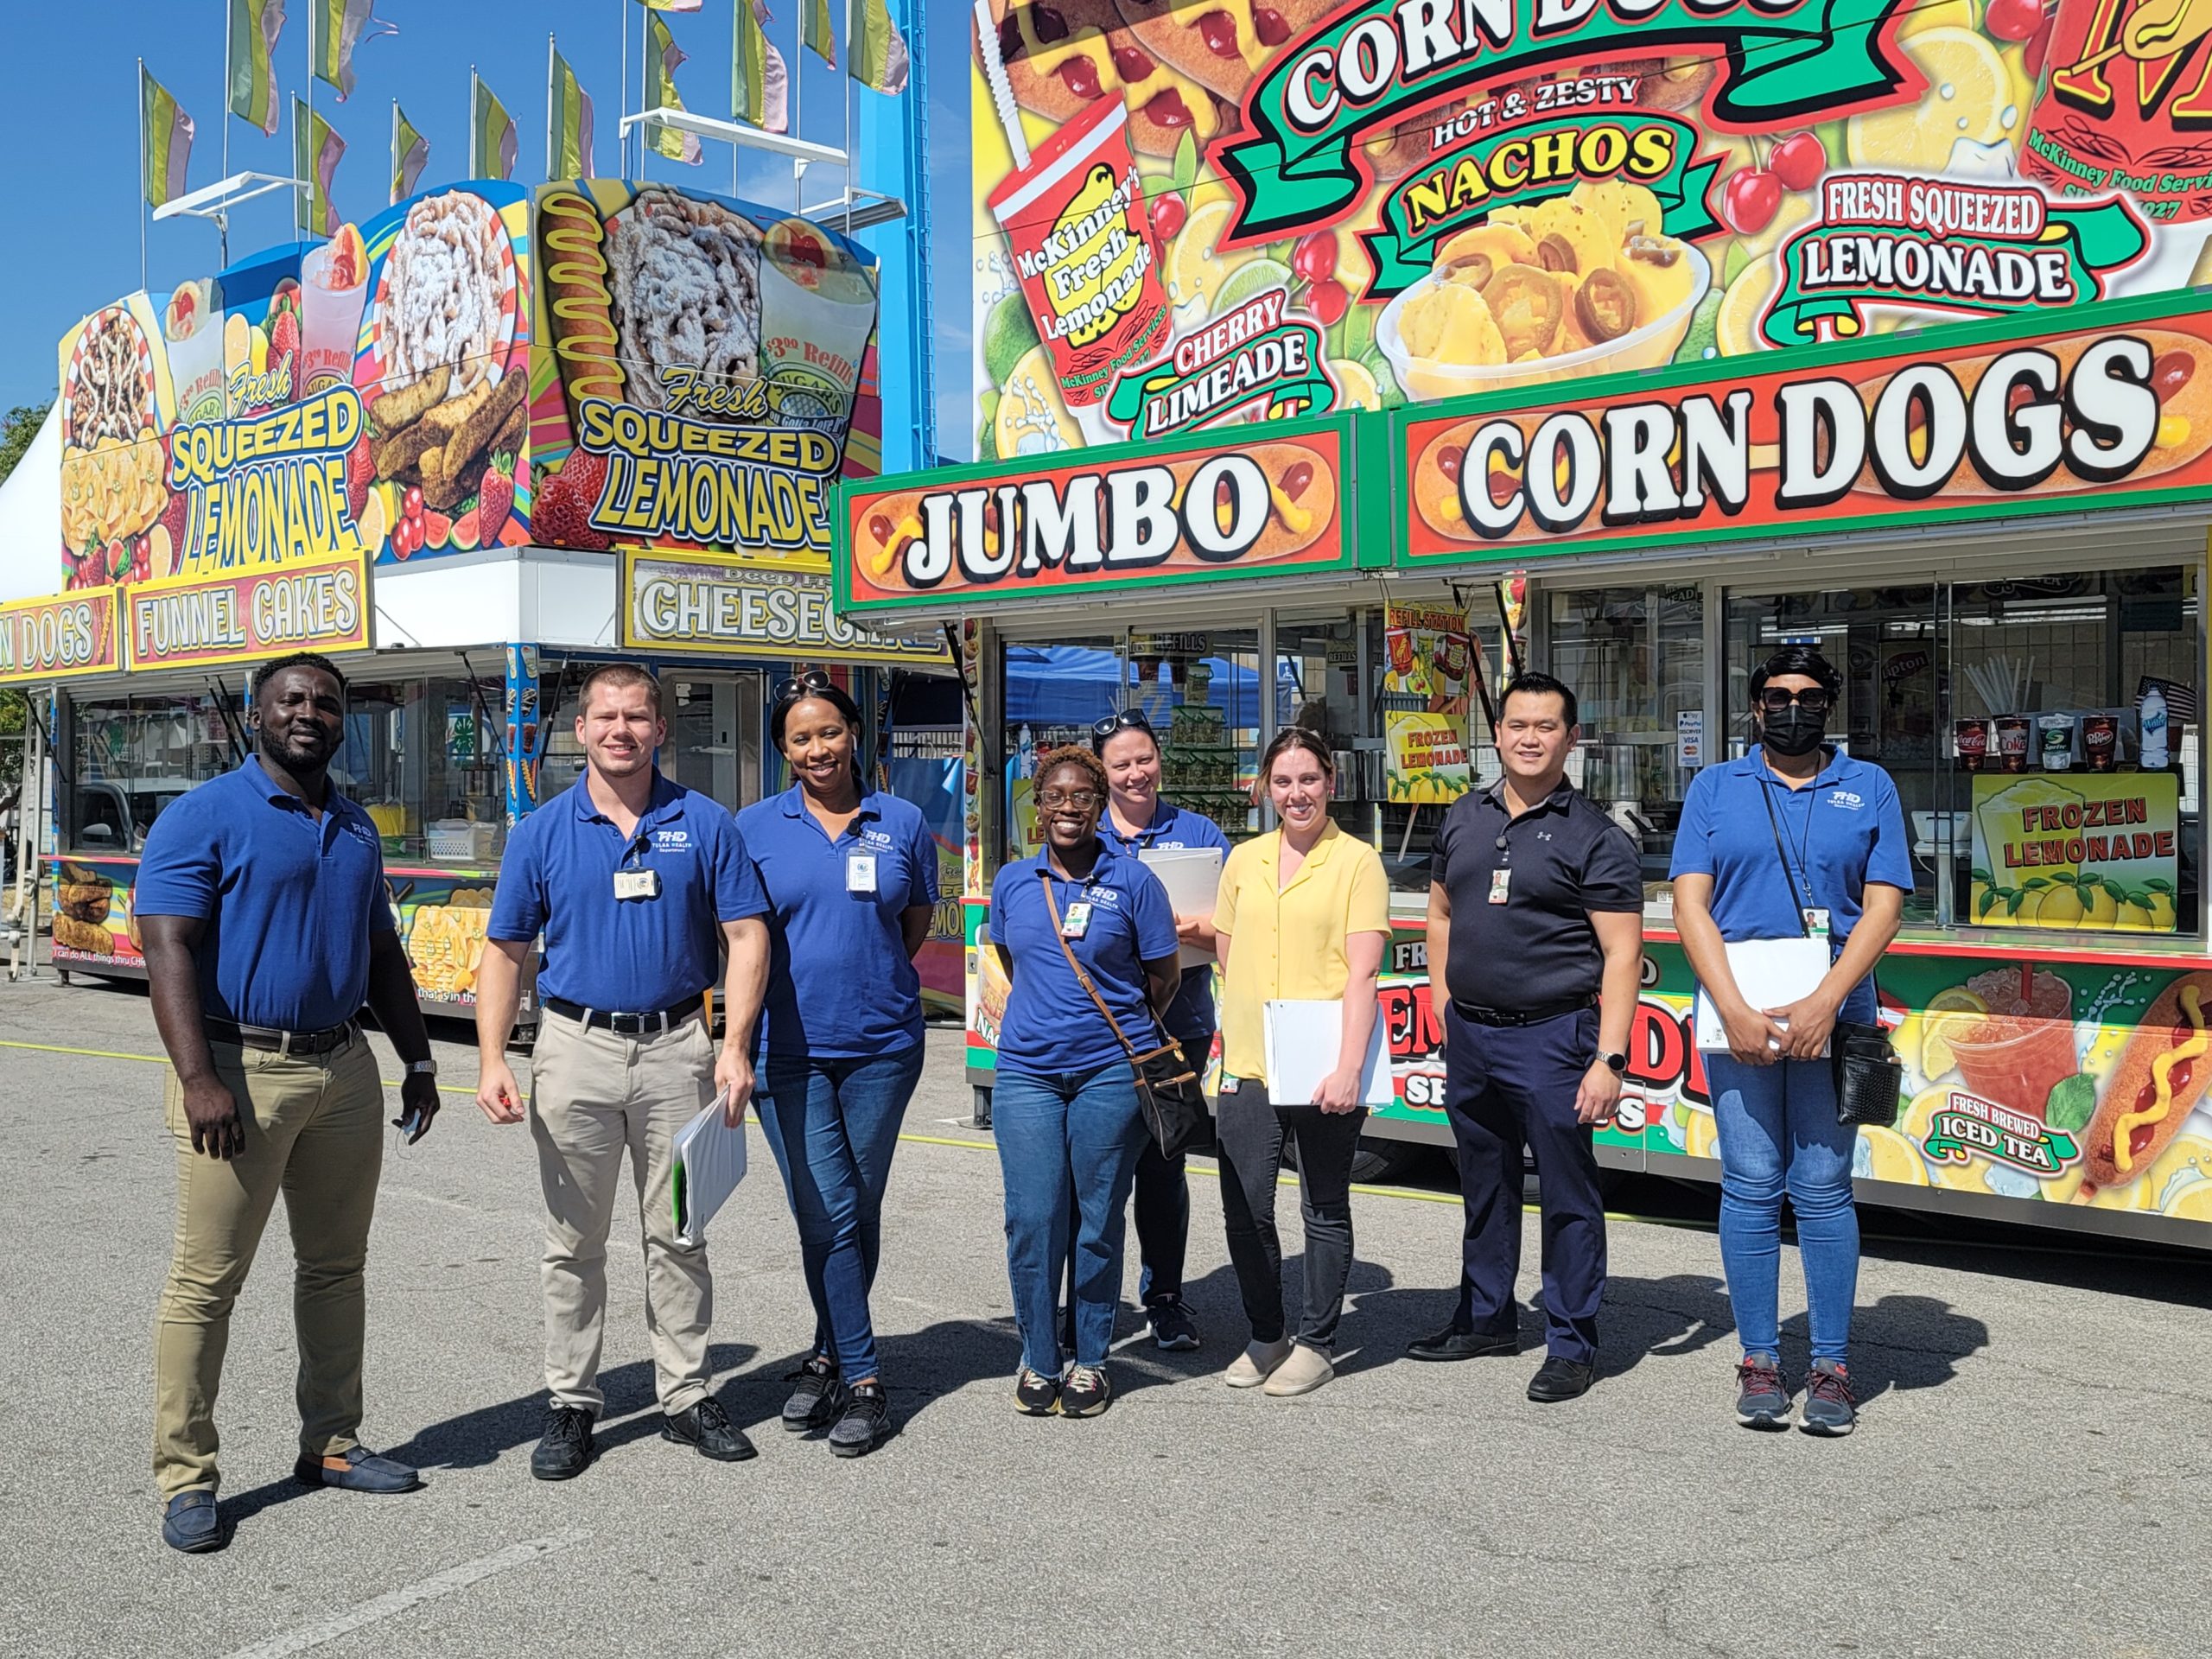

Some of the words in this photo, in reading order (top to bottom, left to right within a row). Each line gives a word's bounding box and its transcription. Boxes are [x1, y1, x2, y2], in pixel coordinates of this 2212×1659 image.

[1286, 0, 1512, 124] CORN
[1433, 101, 1496, 148] HOT
[1503, 92, 1528, 119] &
[1537, 78, 1638, 112] ZESTY
[1406, 129, 1673, 227] NACHOS
[2027, 128, 2107, 188] McKinney
[2108, 169, 2158, 194] Food
[2158, 172, 2212, 194] Servi
[1017, 165, 1141, 280] McKinney's
[1828, 181, 1903, 222] FRESH
[1910, 188, 2040, 236] SQUEEZED
[2138, 200, 2182, 220] 927
[1041, 243, 1151, 340] Lemonade
[1052, 226, 1128, 300] Fresh
[1804, 238, 2072, 299] LEMONADE
[804, 341, 854, 386] Refills
[1061, 366, 1109, 389] McKinney
[1109, 347, 1133, 372] Food
[1132, 303, 1166, 353] Services
[1177, 294, 1281, 373] CHERRY
[230, 350, 292, 419] Fresh
[662, 365, 768, 415] Fresh
[773, 375, 842, 414] SUGAR'S
[1147, 334, 1307, 433] LIMEADE
[173, 389, 359, 486] SQUEEZED
[584, 404, 835, 472] SQUEEZED
[1466, 390, 1752, 534] CORN
[1780, 338, 2158, 510] DOGS
[180, 460, 362, 574] LEMONADE
[594, 457, 831, 543] LEMONADE
[906, 454, 1270, 582] JUMBO
[722, 568, 795, 586] Deep
[22, 604, 93, 667] DOGS
[136, 586, 246, 658] FUNNEL
[251, 569, 359, 645] CAKES
[1389, 607, 1422, 629] REFILL
[1424, 612, 1465, 632] STATION
[1328, 652, 1357, 663] REFILLS
[1882, 654, 1928, 679] Lipton
[1401, 748, 1469, 769] LEMONADE
[1407, 729, 1458, 747] FROZEN
[2000, 737, 2026, 751] Coke
[2023, 798, 2147, 832] FROZEN
[2005, 831, 2175, 868] LEMONADE
[70, 950, 79, 958] do
[79, 951, 93, 961] ALL
[93, 952, 114, 964] things
[115, 955, 130, 964] thru
[418, 988, 438, 1000] that
[1942, 1116, 1998, 1147] ICED
[2003, 1134, 2050, 1166] TEA
[1953, 1096, 1989, 1118] FRESH
[1991, 1106, 2040, 1139] BREWED
